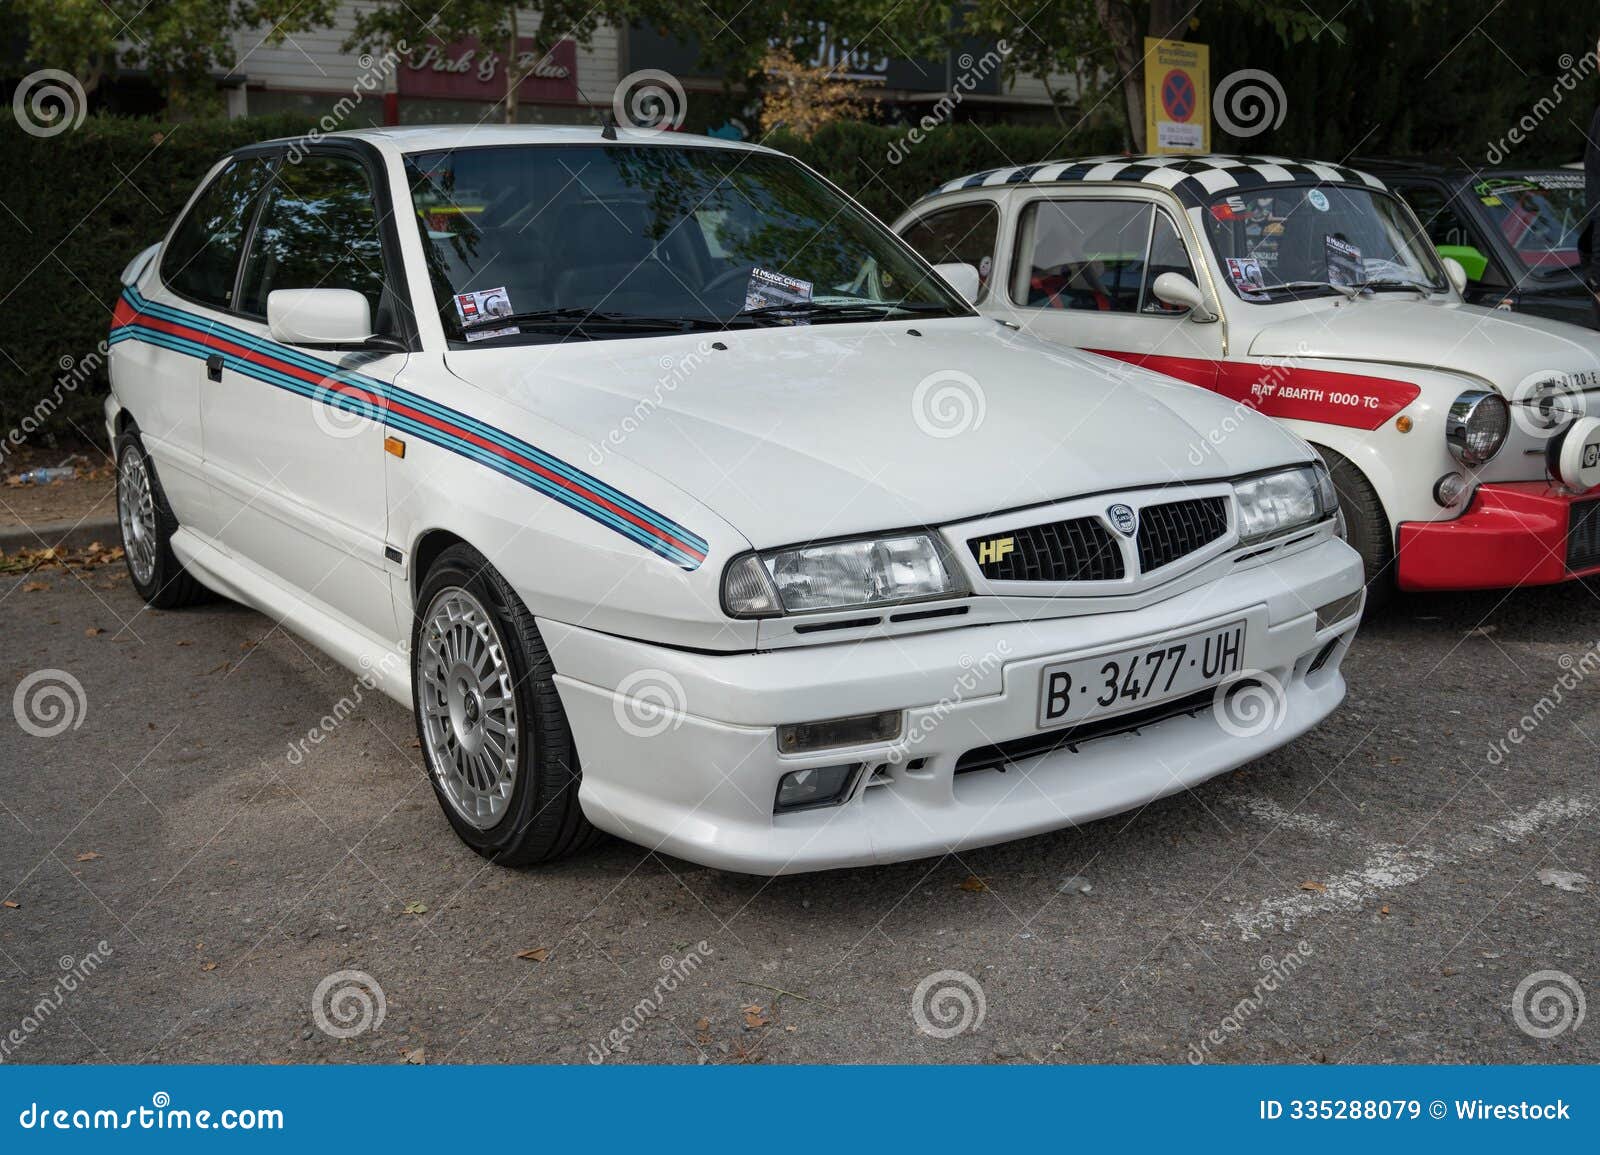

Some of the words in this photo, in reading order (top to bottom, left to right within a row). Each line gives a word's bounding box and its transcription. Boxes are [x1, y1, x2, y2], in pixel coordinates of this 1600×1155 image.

[1251, 383, 1275, 396] FIAT
[1277, 387, 1324, 401] ABARTH
[1328, 392, 1360, 406] 1000
[1362, 396, 1380, 409] TC
[979, 537, 1014, 565] HF
